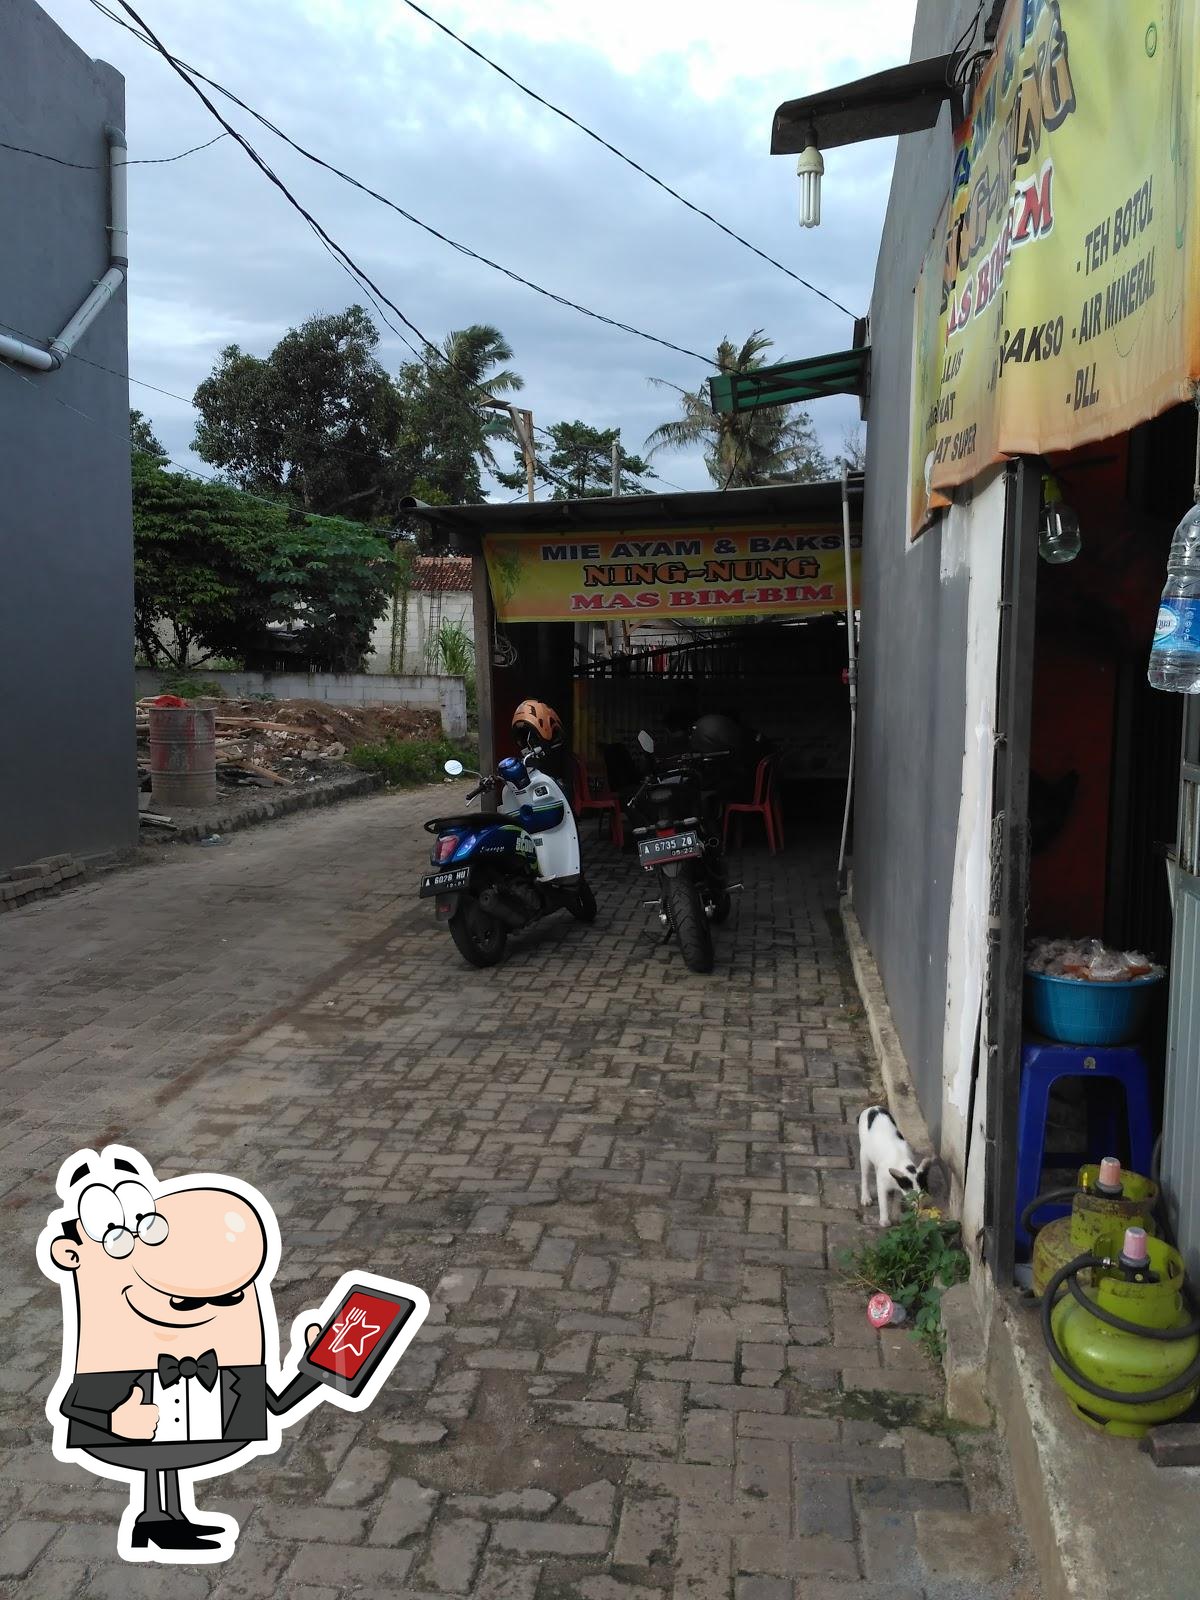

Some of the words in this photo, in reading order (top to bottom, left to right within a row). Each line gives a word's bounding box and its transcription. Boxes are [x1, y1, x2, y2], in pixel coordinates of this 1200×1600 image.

[1085, 216, 1110, 275] TEH
[1113, 175, 1153, 255] BOTOL
[1079, 292, 1102, 345] AIR
[1105, 246, 1155, 330] MINERAL
[951, 423, 976, 461] SUPER
[542, 543, 601, 561] MIE
[609, 540, 701, 559] AYAM
[713, 538, 737, 554] &
[583, 555, 821, 587] NING-NUNG
[570, 591, 661, 610] MAS
[669, 584, 834, 606] BIM-BIM
[644, 845, 650, 854] A
[654, 840, 677, 852] 6735
[425, 878, 431, 887] A
